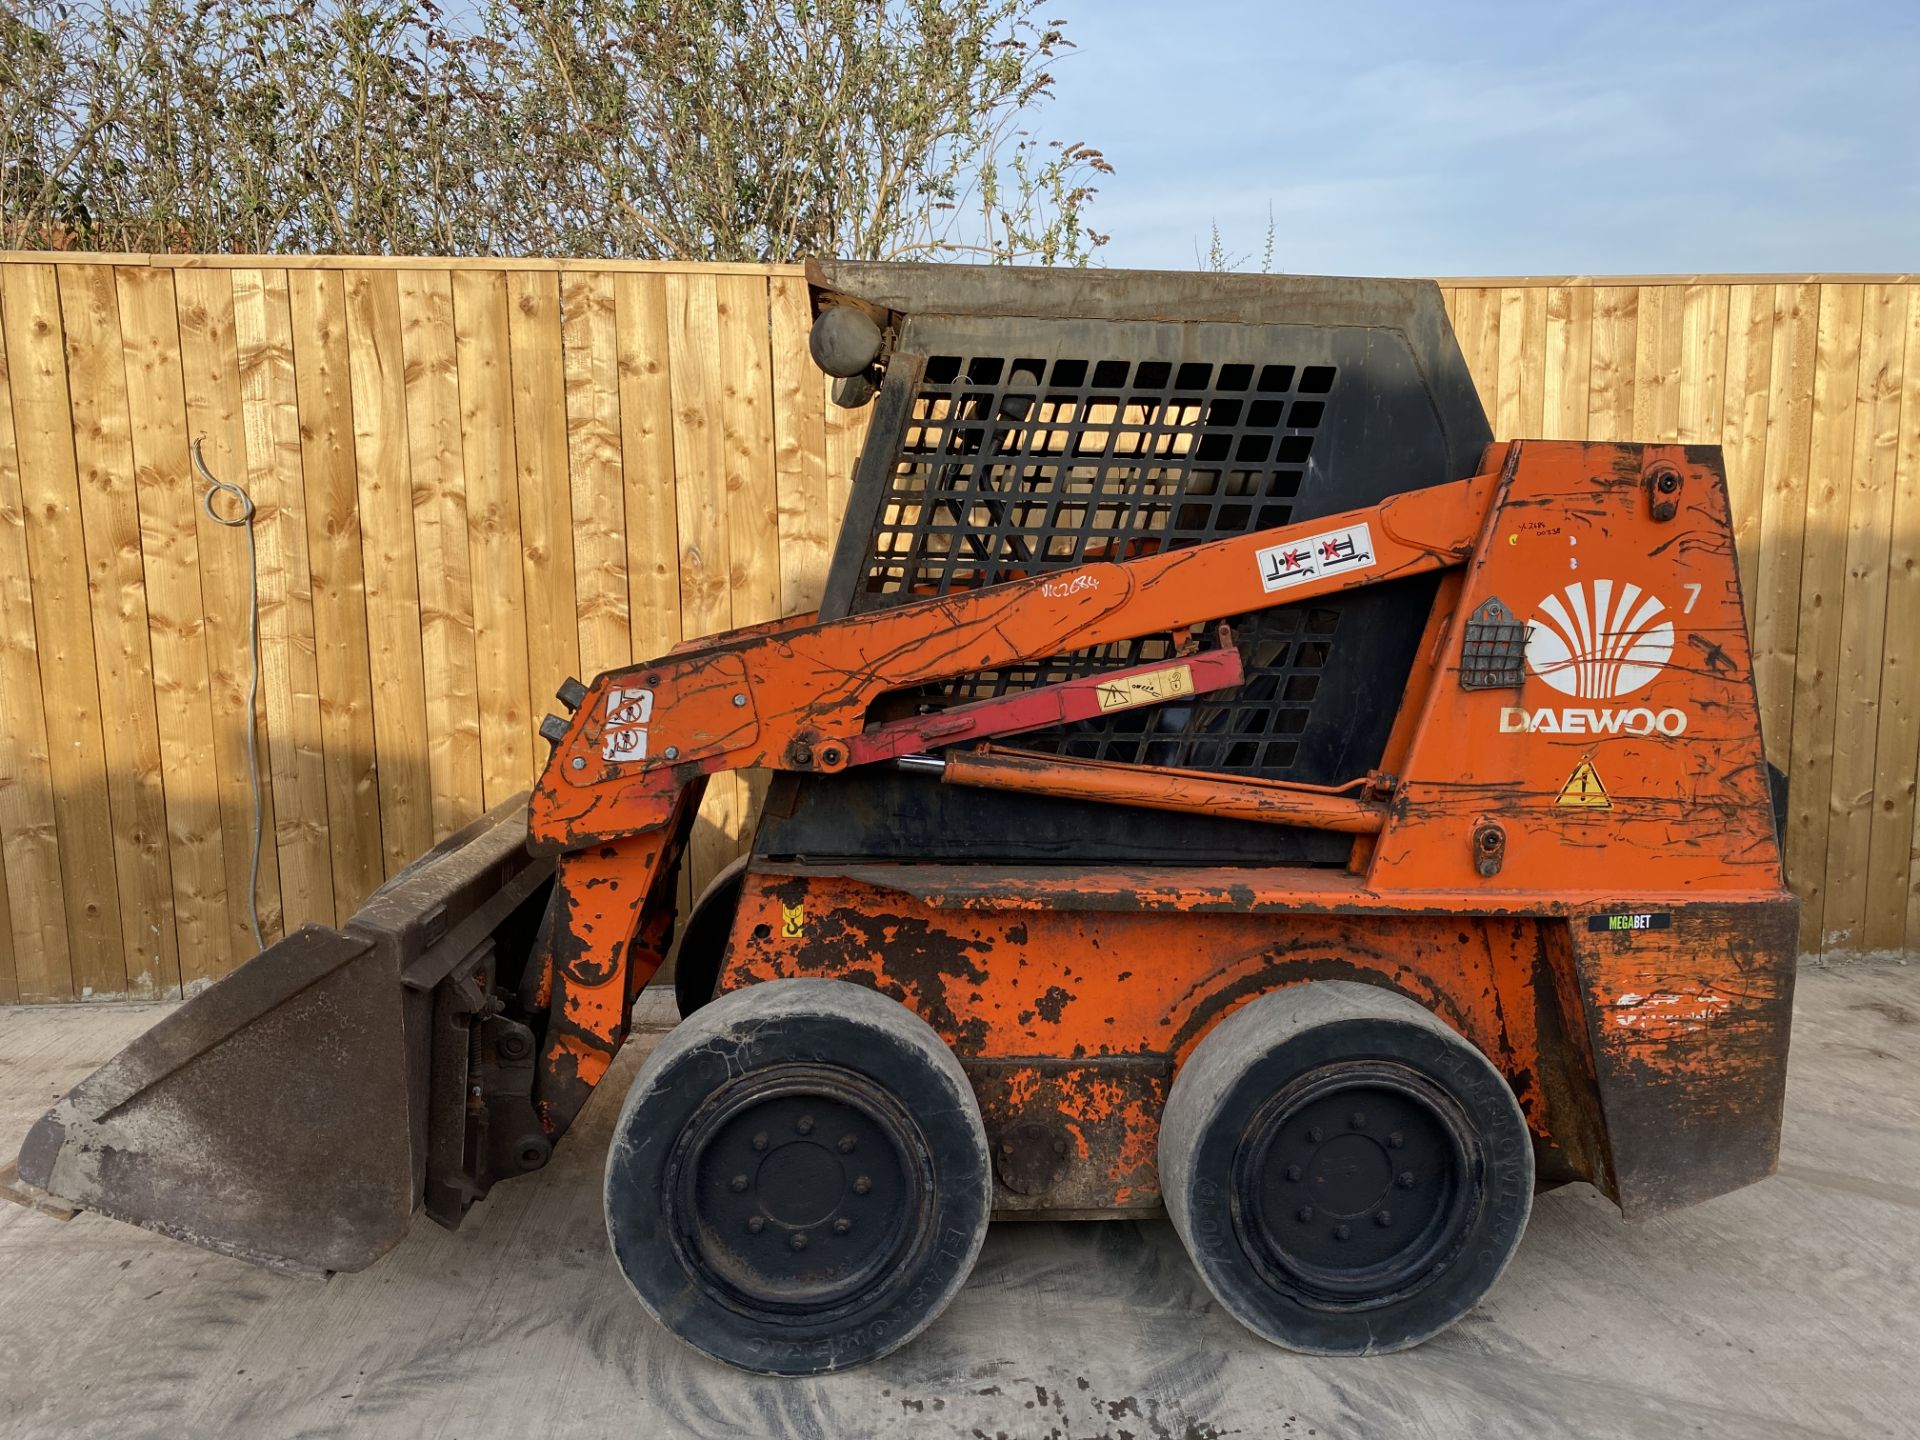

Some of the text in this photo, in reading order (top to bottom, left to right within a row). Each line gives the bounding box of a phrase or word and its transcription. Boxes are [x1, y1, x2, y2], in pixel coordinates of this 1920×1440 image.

[1683, 583, 1702, 614] 7
[1499, 707, 1688, 737] DAEWOO
[1608, 914, 1652, 930] MEGABET
